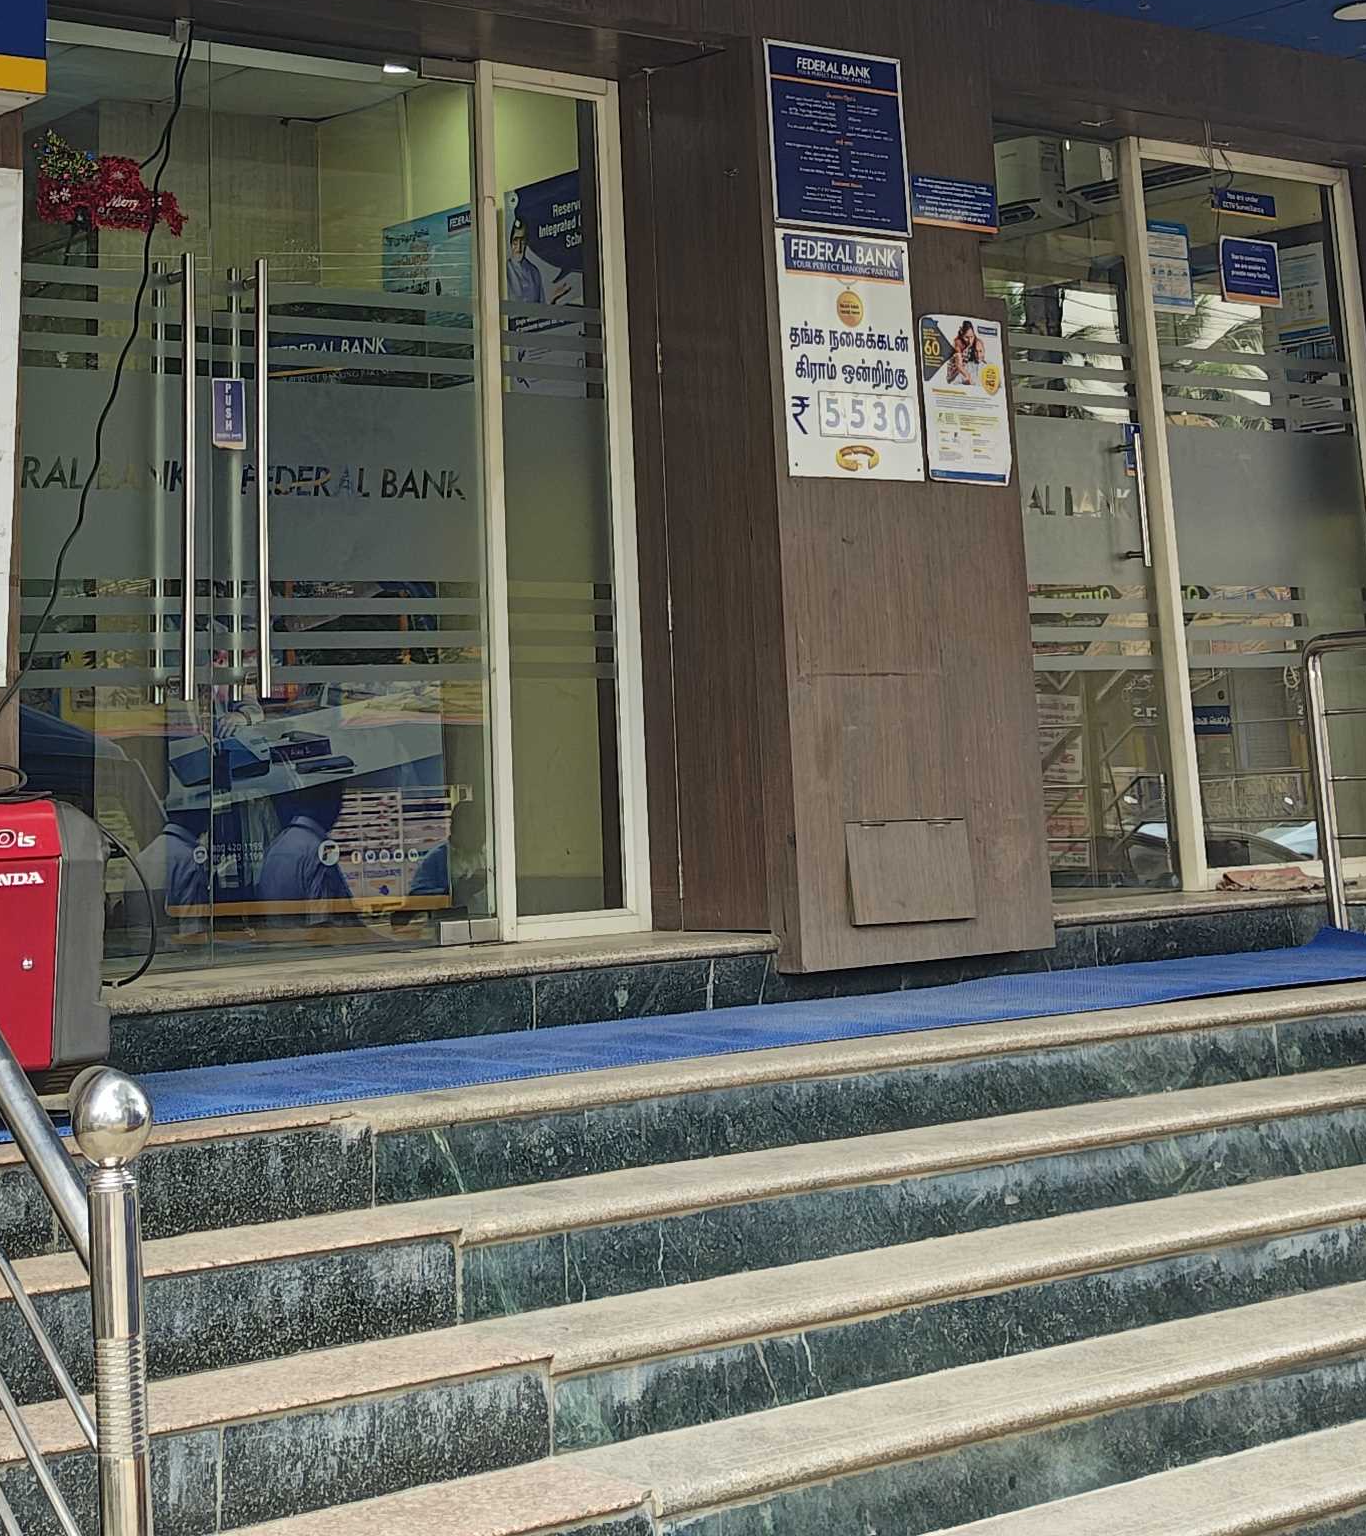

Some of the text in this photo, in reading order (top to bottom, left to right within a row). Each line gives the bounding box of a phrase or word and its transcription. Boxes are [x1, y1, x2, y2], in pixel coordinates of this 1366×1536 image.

[796, 56, 839, 75] FEDERAL
[841, 64, 871, 79] BANK
[791, 238, 898, 269] FEDERAL BANK
[789, 321, 909, 353] தங்க நகைக்கடன்
[924, 340, 940, 356] 60
[795, 353, 909, 390] கிராம் ஒன்றிற்கு
[223, 383, 233, 431] PUSH
[381, 468, 467, 500] BANK
